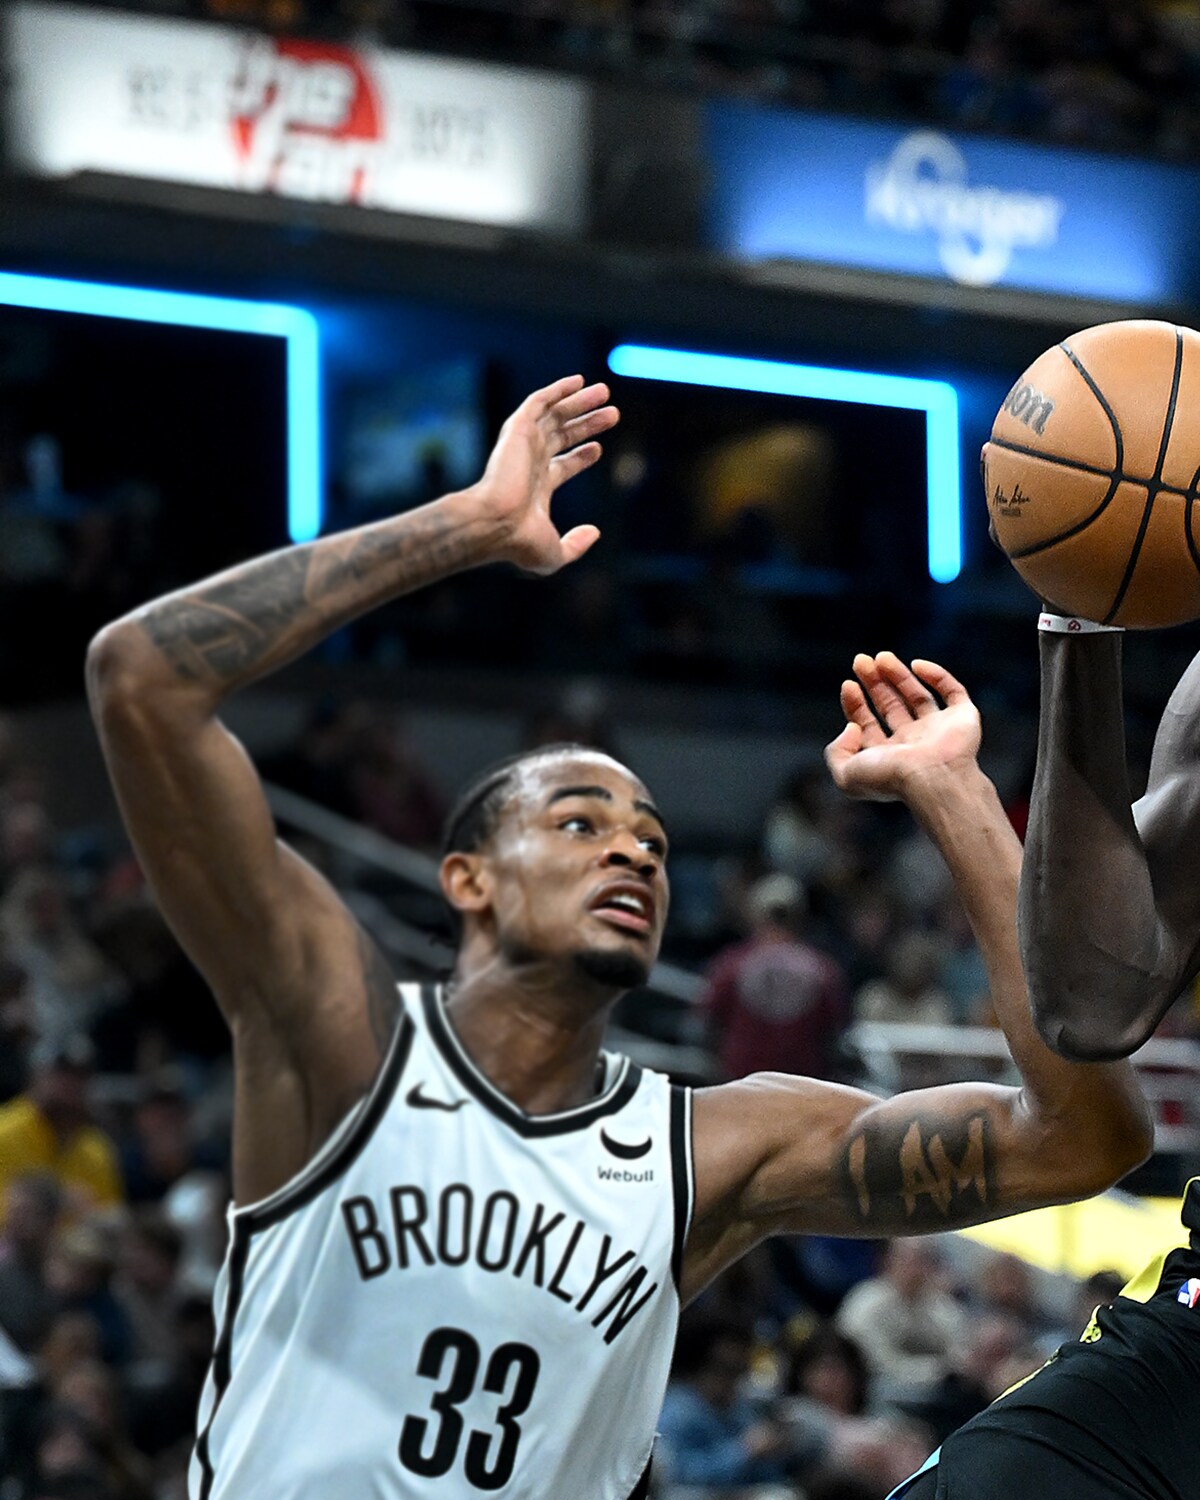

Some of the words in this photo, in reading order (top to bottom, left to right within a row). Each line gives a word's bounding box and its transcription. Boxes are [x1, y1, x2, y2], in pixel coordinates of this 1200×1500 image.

[597, 1165, 654, 1183] Webull
[900, 1116, 988, 1218] AM
[341, 1183, 657, 1345] BROOKLYN
[399, 1326, 541, 1491] 33
